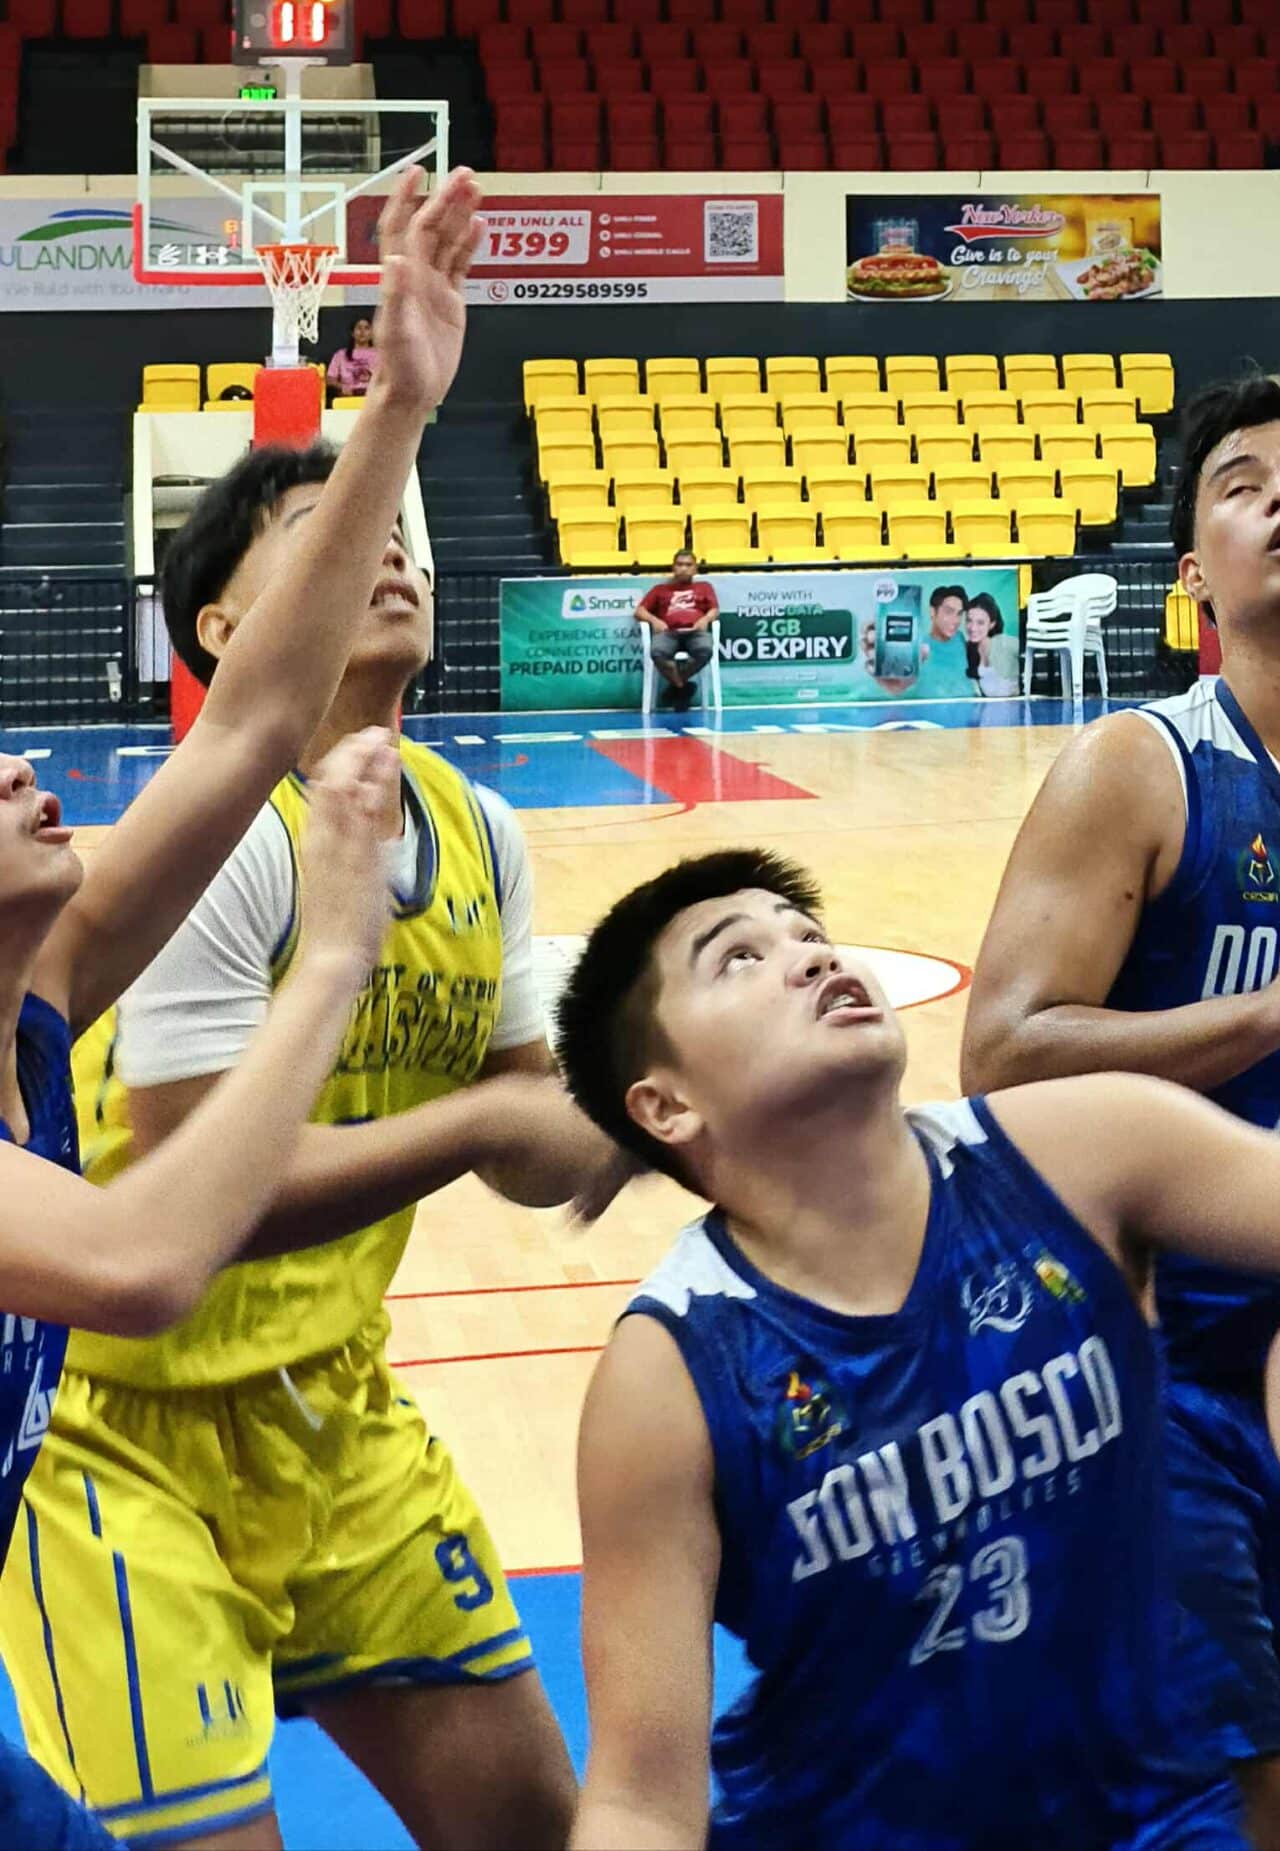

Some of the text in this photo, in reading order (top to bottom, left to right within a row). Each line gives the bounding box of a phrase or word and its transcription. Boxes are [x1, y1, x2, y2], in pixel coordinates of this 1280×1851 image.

[558, 216, 585, 227] ALL
[489, 232, 570, 257] 1399
[950, 245, 986, 264] Give
[988, 248, 1003, 262] in
[1006, 247, 1022, 262] to
[513, 283, 648, 299] 09229589595
[589, 596, 635, 610] Smart
[748, 590, 813, 601] NOW WITH
[756, 618, 801, 637] 2 GB
[718, 635, 848, 660] NO EXPIRY
[509, 658, 644, 675] PREPAID DIGITA
[917, 1335, 1123, 1525] BOSCO
[433, 1533, 494, 1612] 9
[908, 1534, 1032, 1666] 23
